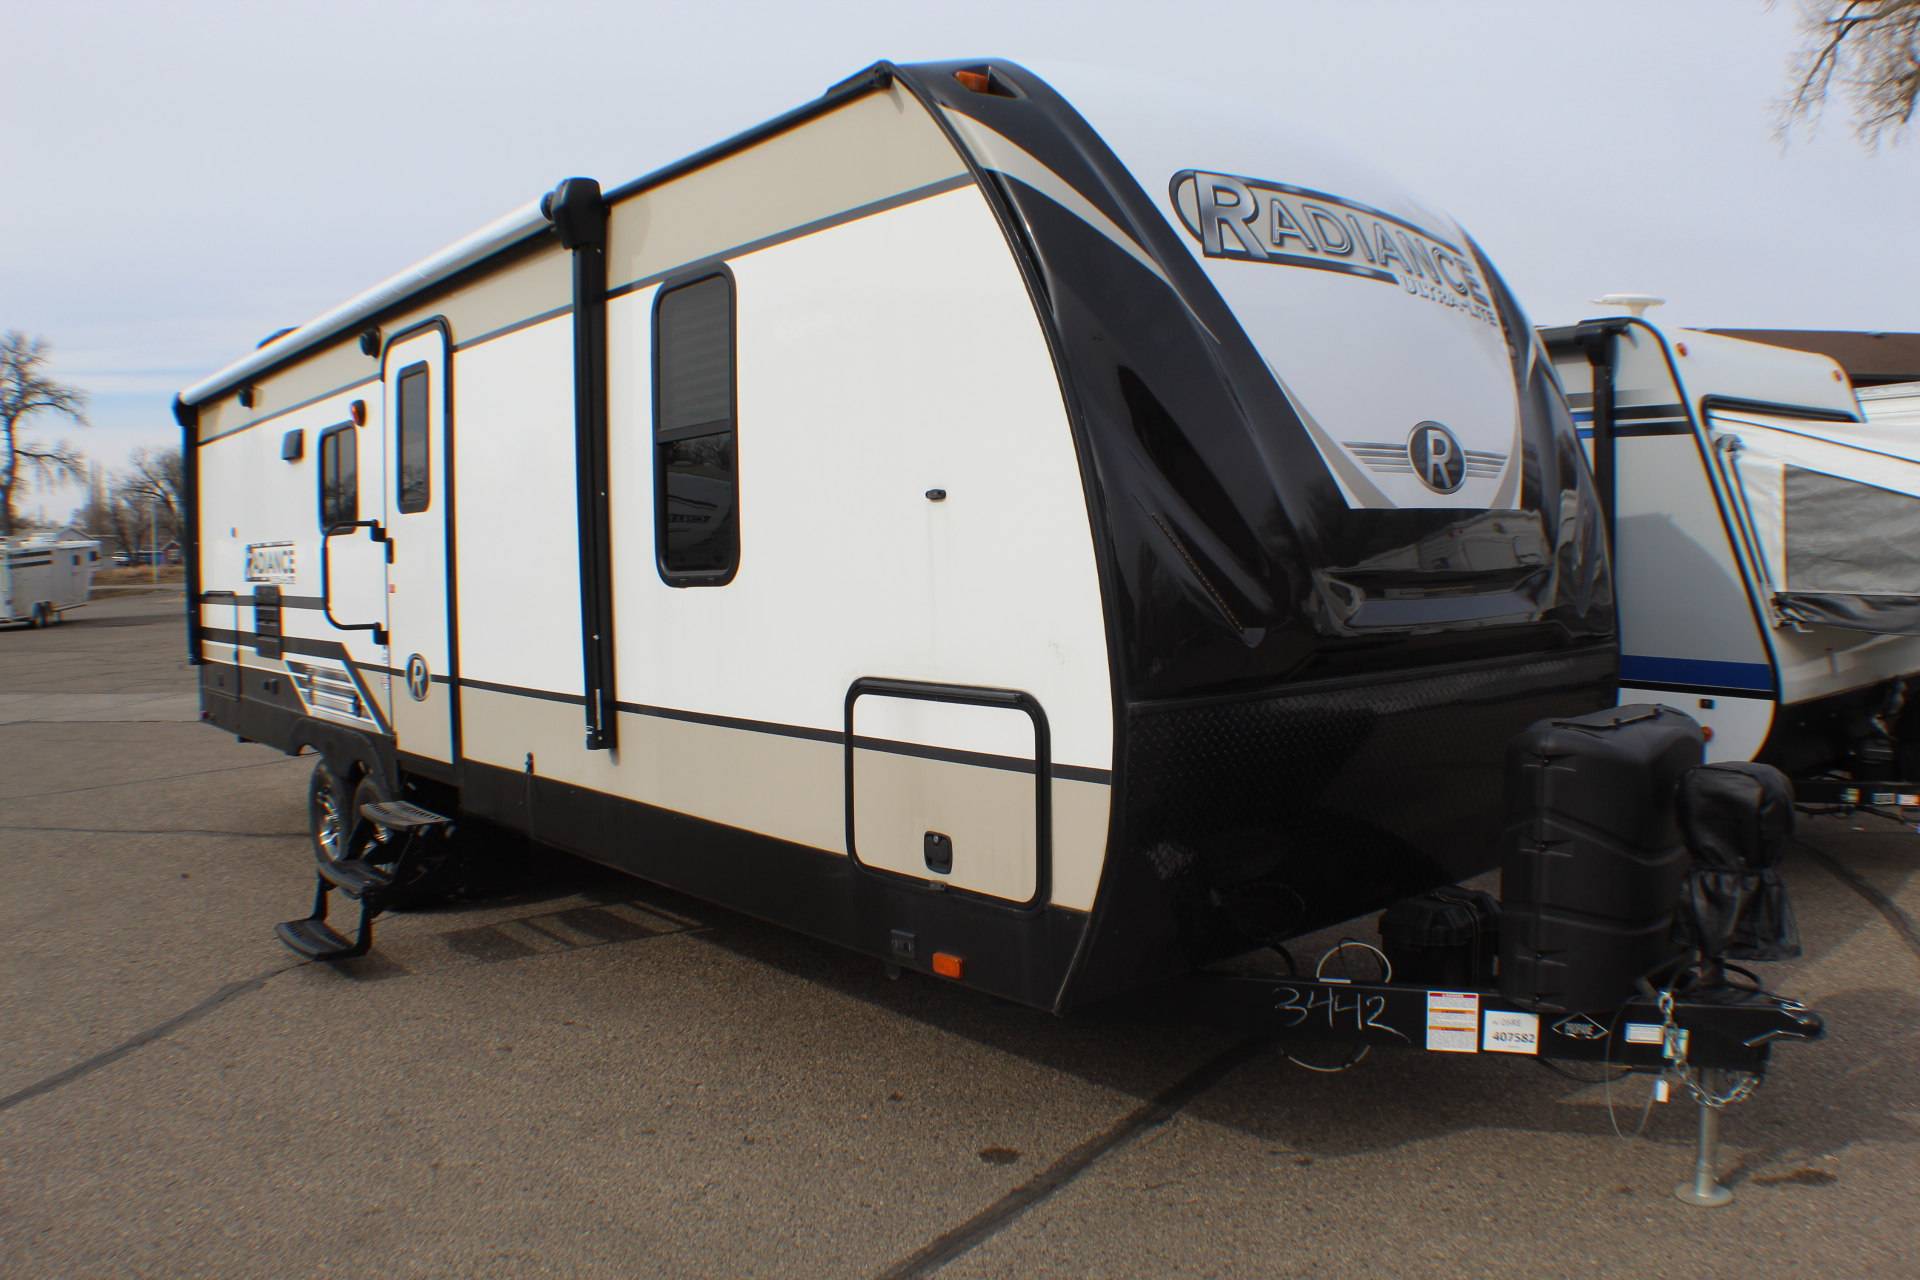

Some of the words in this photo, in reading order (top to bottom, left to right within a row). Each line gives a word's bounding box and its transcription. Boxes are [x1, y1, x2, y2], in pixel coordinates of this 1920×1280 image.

[1194, 169, 1490, 309] RADIANCE
[1425, 428, 1454, 489] R
[246, 545, 296, 580] RADIANCE
[1272, 986, 1412, 1044] 3442
[1491, 1031, 1536, 1044] 407582
